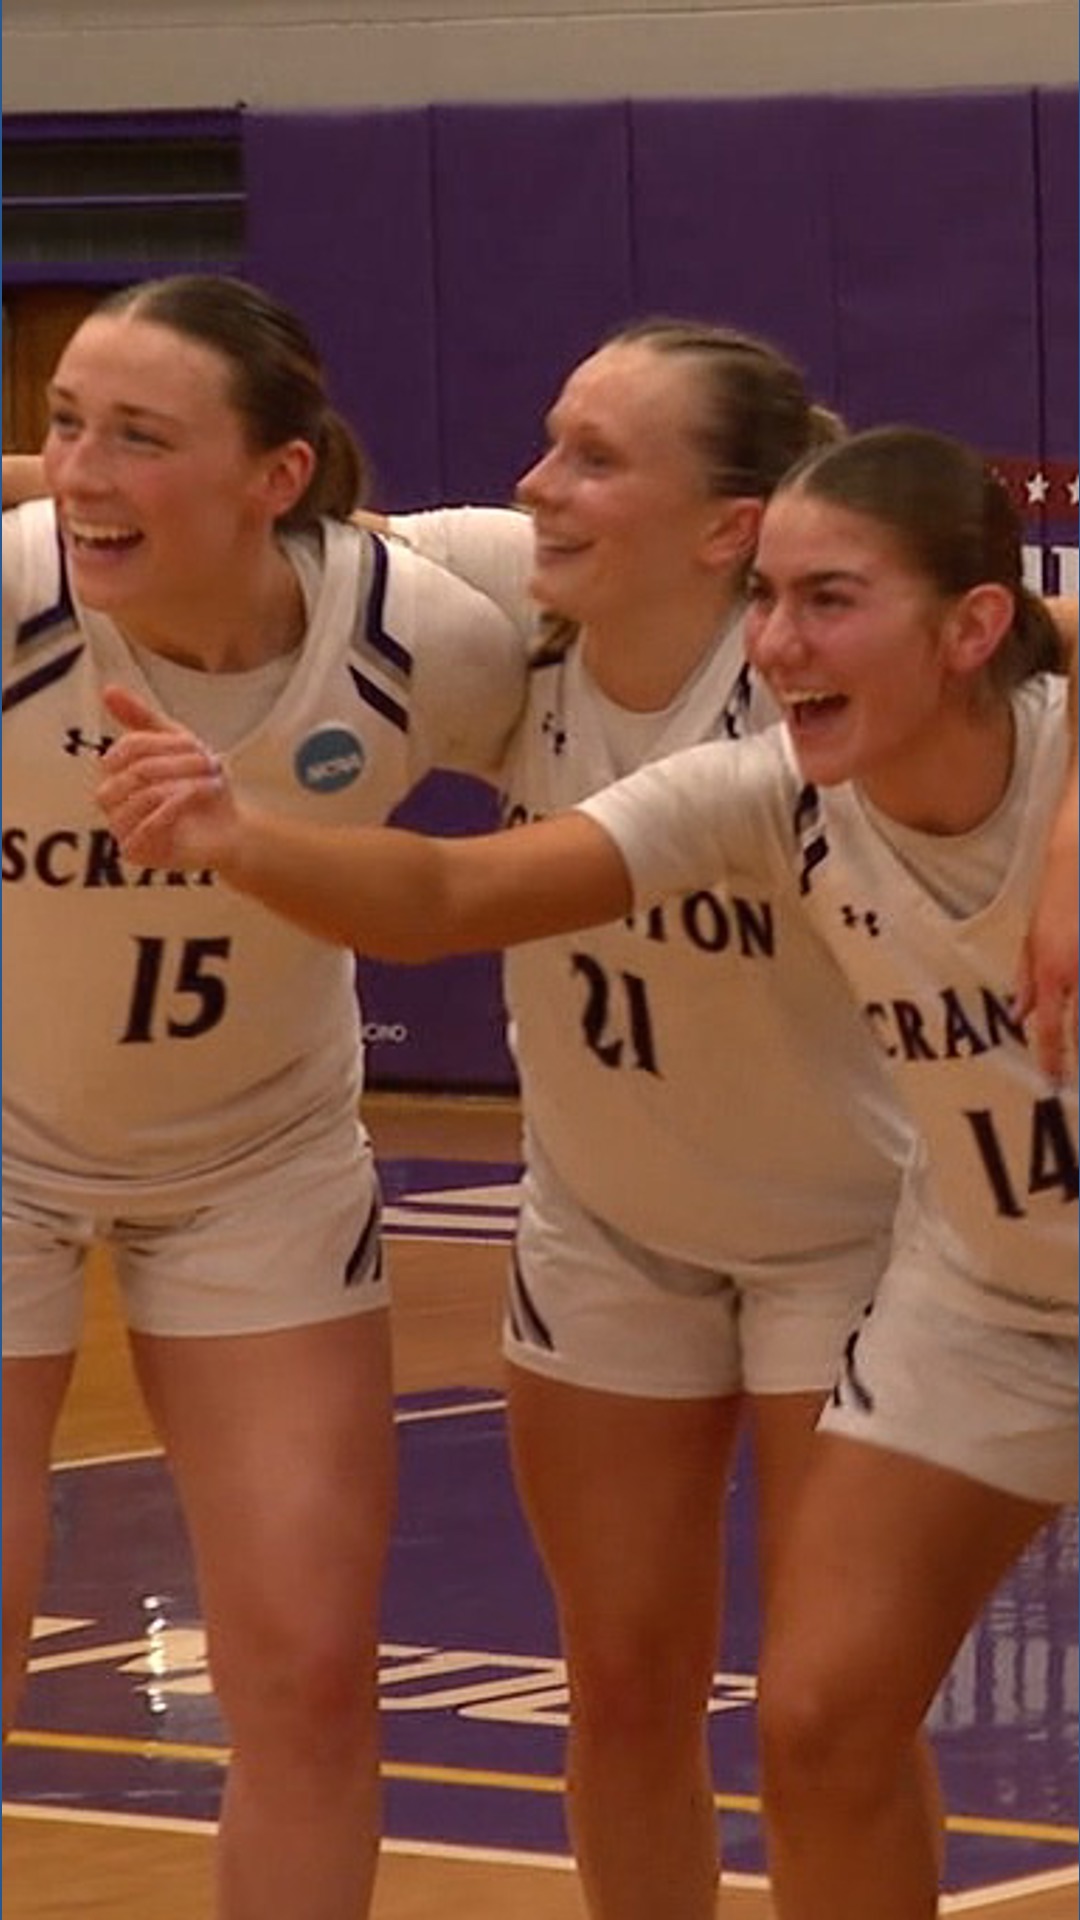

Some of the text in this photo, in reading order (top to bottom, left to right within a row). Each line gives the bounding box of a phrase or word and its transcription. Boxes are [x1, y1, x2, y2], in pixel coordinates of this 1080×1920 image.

[2, 828, 216, 888] SCR
[118, 936, 231, 1043] 15
[568, 953, 662, 1078] 21
[963, 1096, 1079, 1218] 14
